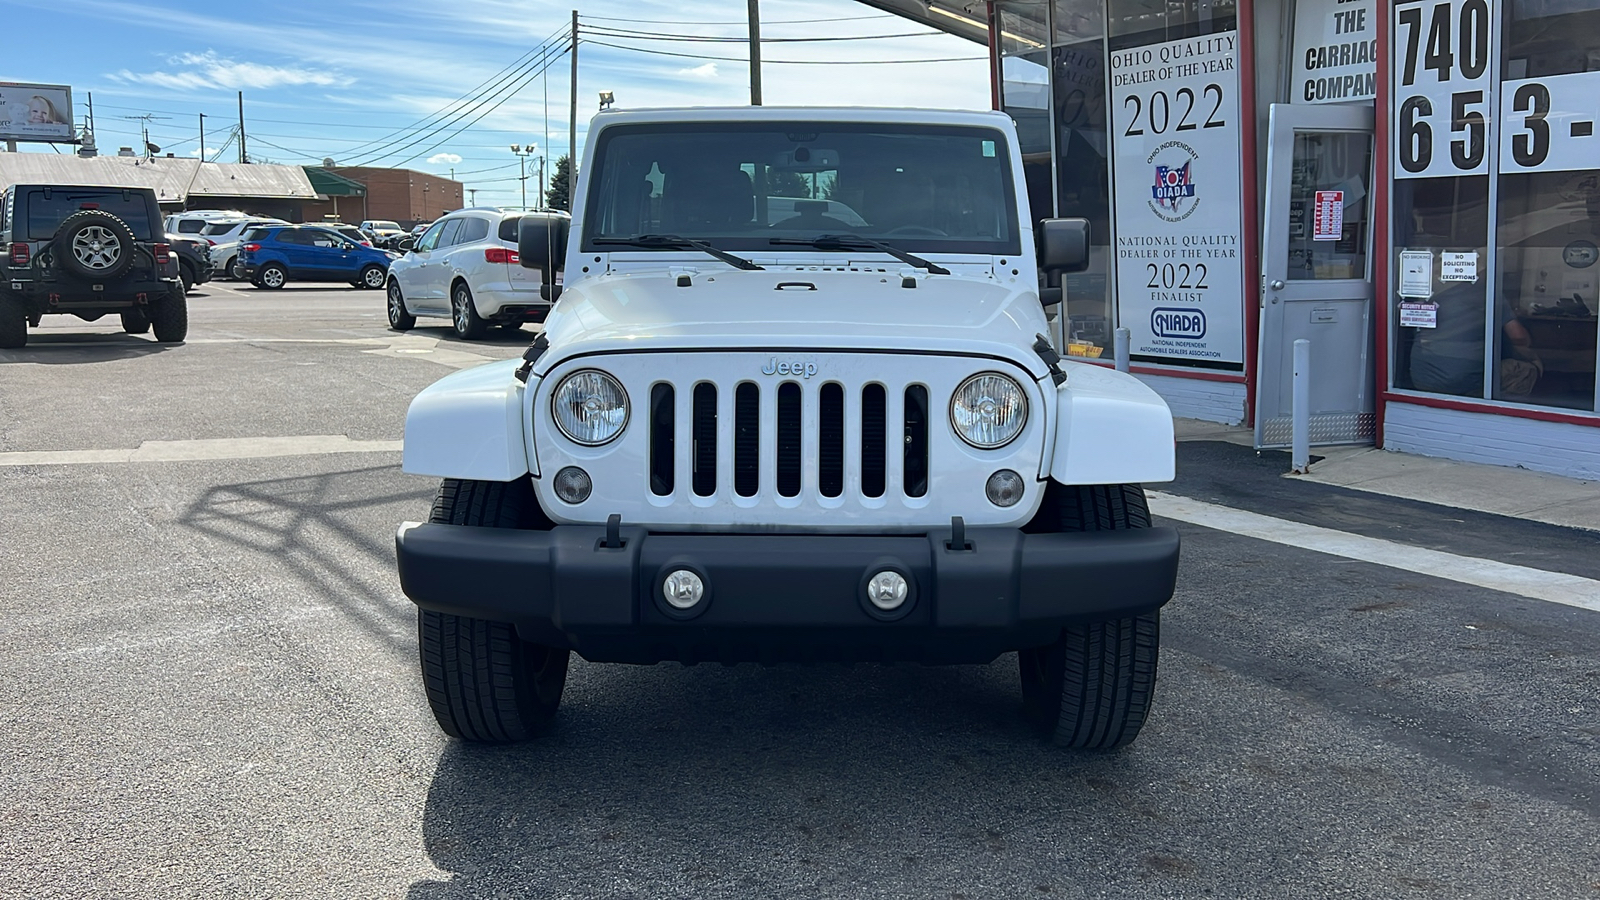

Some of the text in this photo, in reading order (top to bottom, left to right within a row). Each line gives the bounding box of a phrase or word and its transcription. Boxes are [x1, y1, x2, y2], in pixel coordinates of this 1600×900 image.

[1334, 8, 1366, 35] THE
[1112, 35, 1236, 69] OHIO QUALITY
[1399, 0, 1489, 86] 740
[1114, 57, 1234, 87] DEALER OF THE YEAR
[1124, 83, 1225, 137] 2022
[1147, 141, 1199, 165] OHIO INDEPENDENT
[1157, 186, 1188, 198] OIADA
[1147, 200, 1165, 221] AUTOMOBILE
[1181, 197, 1201, 220] ASSOCIATION
[1119, 235, 1237, 247] NATIONAL QUALITY
[1120, 249, 1236, 258] DEALER OF THE YEAR
[1146, 263, 1208, 289] 2022
[1151, 292, 1203, 302] FINALIST
[1155, 314, 1201, 334] NIADA
[1140, 346, 1221, 358] AUTOMOBILE DEALERS ASSOCIATION
[1152, 339, 1207, 349] NATIONAL INDEPENDENT
[761, 357, 818, 379] Jeep
